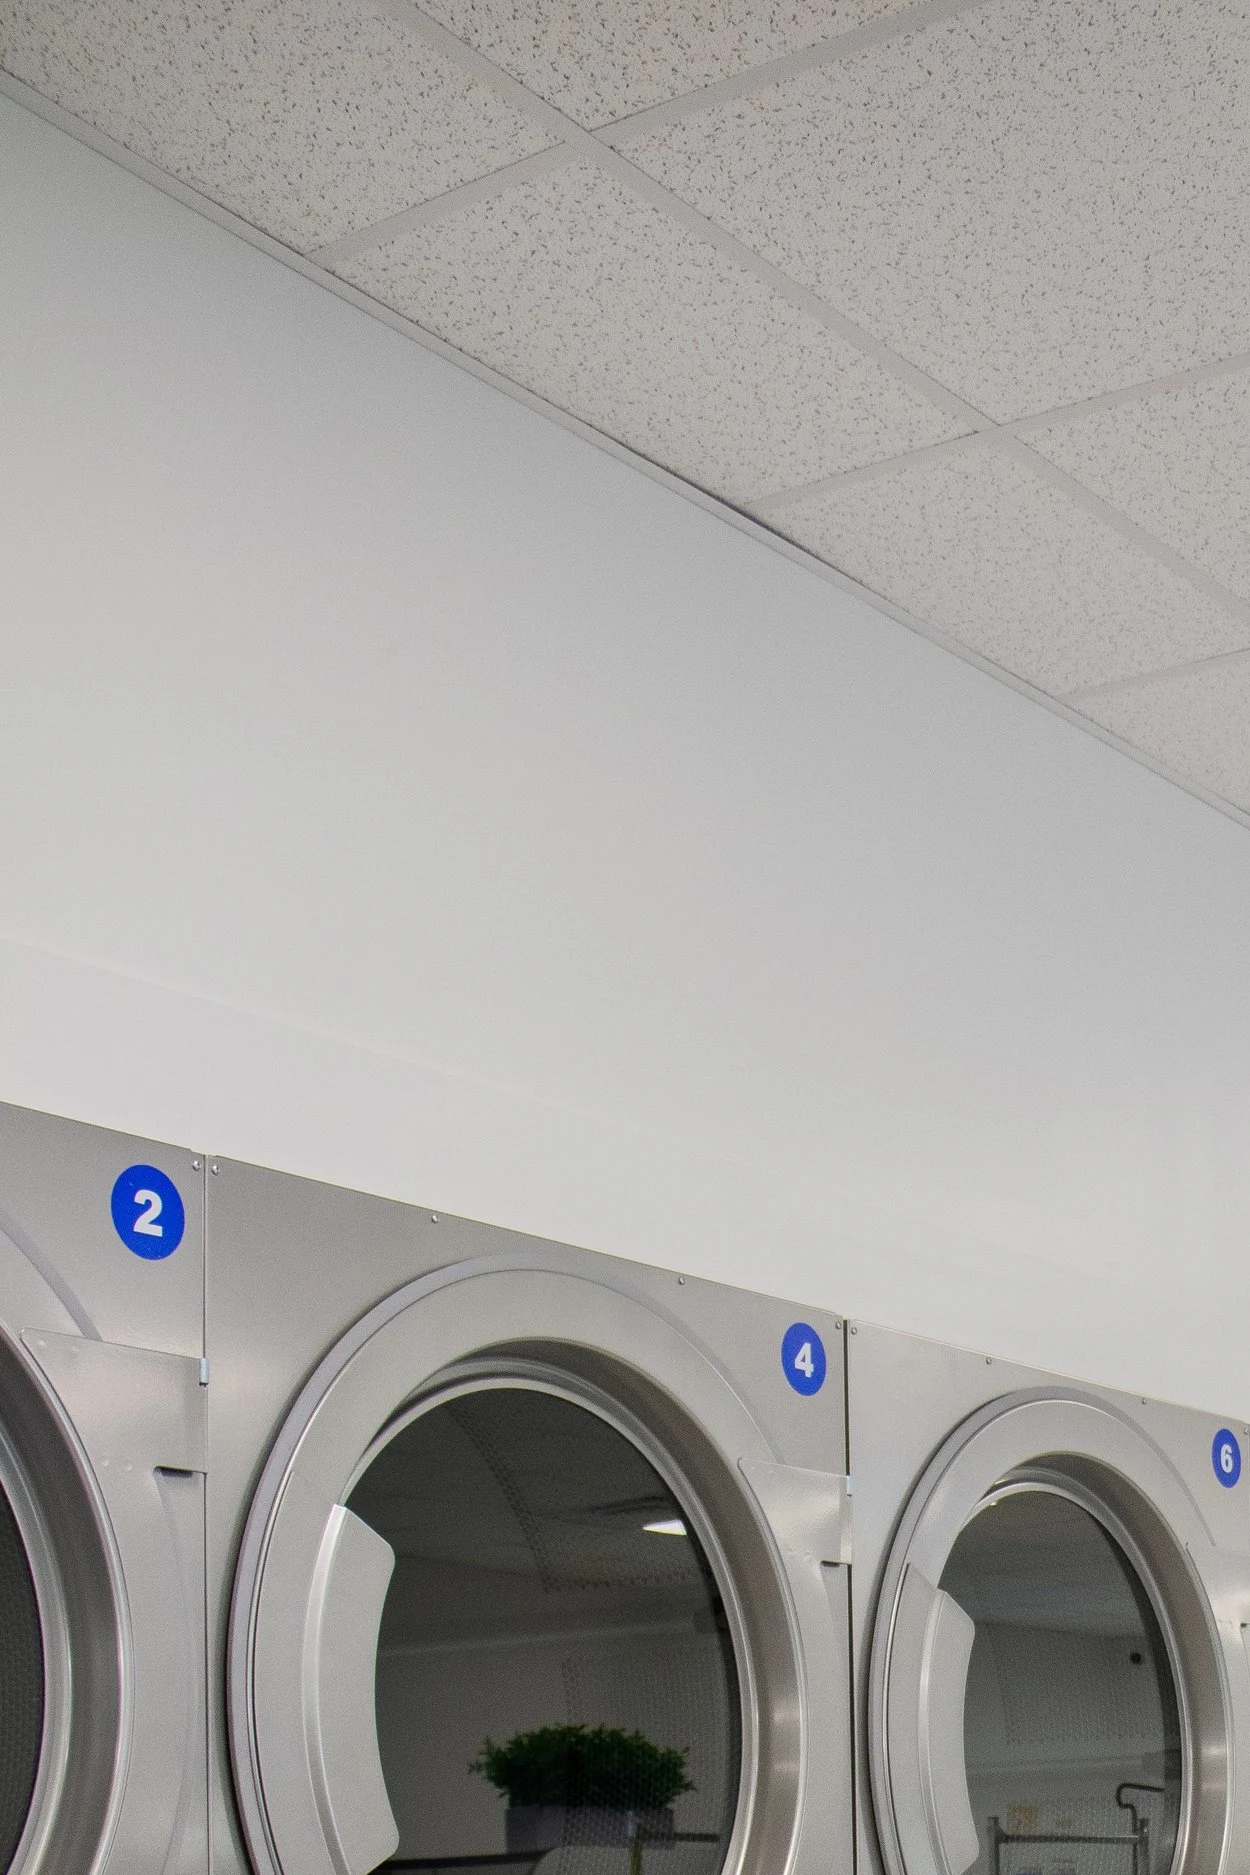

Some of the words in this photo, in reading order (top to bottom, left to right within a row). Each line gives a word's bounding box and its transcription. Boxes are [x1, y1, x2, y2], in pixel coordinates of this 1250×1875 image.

[133, 1189, 163, 1237] 2
[795, 1342, 814, 1378] 4
[1221, 1444, 1233, 1473] 6
